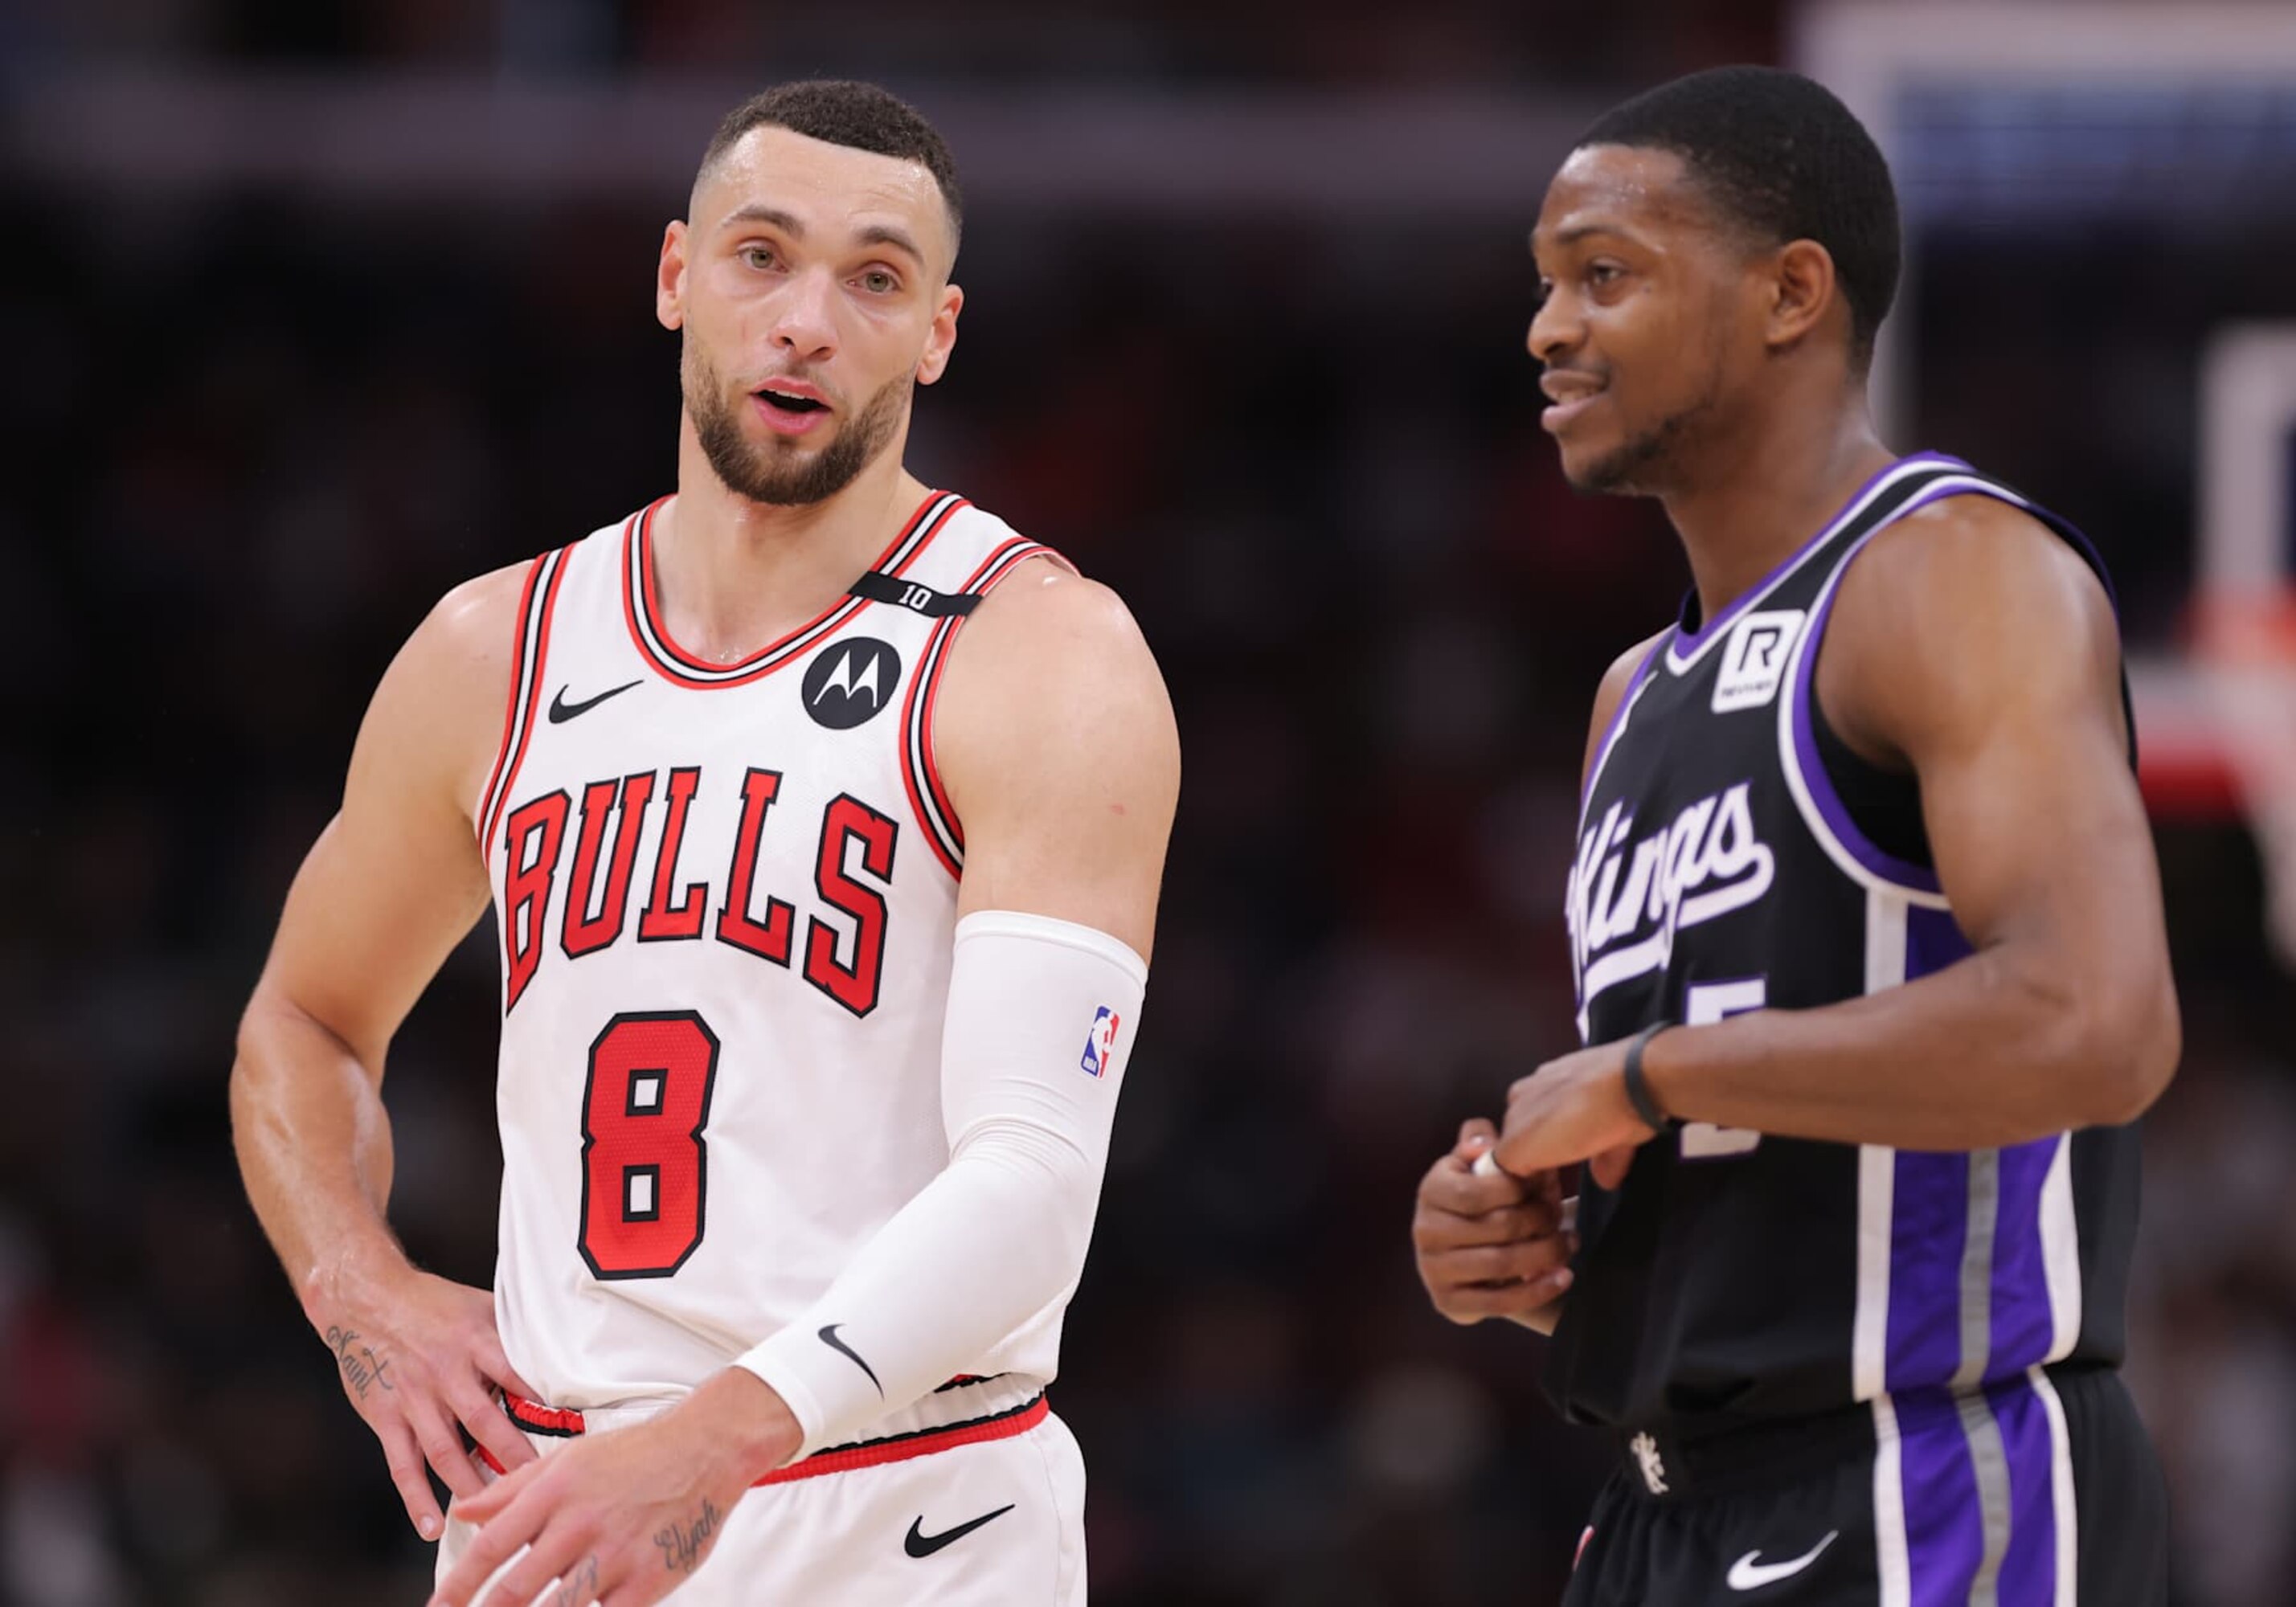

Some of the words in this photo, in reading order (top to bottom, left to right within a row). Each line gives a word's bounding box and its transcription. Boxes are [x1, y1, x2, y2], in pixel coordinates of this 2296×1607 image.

[898, 583, 932, 611] 10
[505, 766, 899, 1019] BULLS
[577, 1009, 721, 1281] 8
